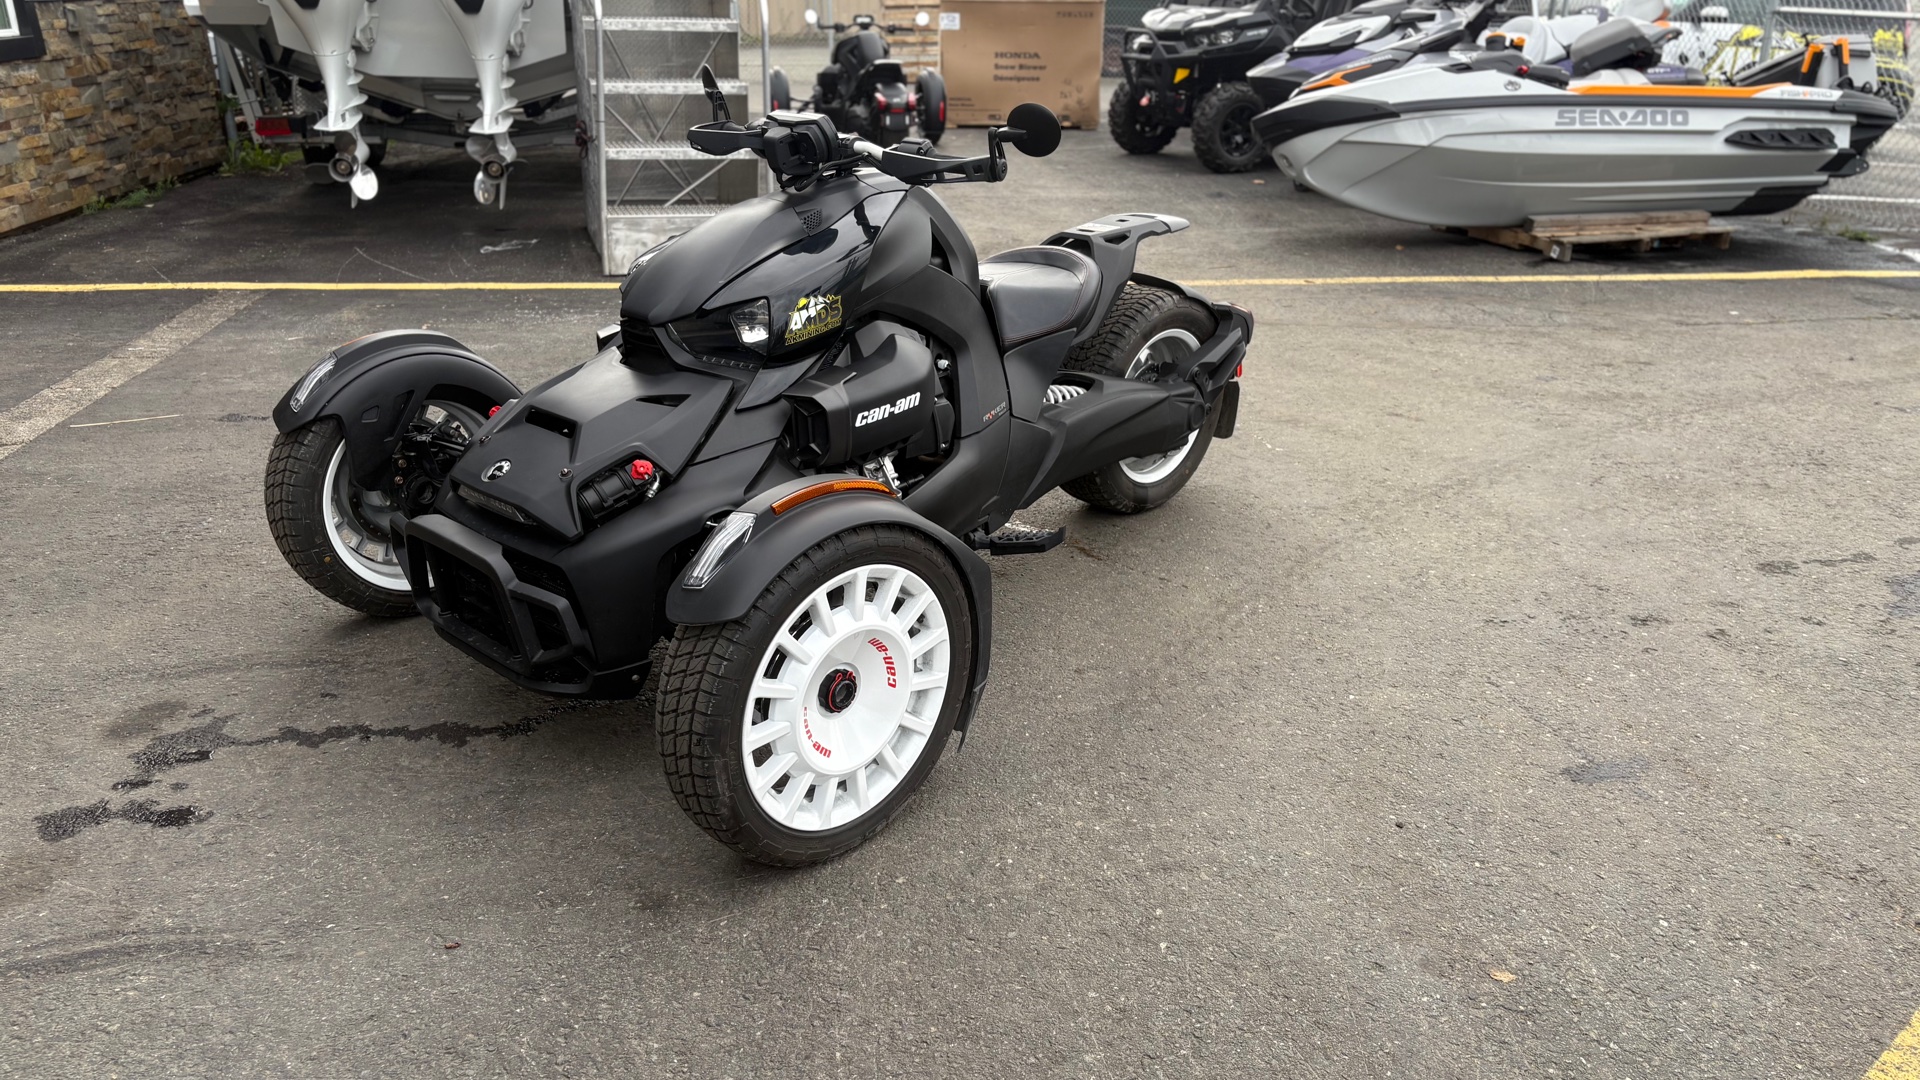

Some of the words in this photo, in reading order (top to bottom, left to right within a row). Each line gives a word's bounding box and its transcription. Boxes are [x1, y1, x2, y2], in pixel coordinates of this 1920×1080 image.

[994, 51, 1042, 60] HONDA
[994, 63, 1016, 71] Snow
[1018, 63, 1047, 71] Blower
[785, 294, 843, 338] AMDS
[854, 391, 921, 428] can-am
[867, 637, 897, 689] can-am
